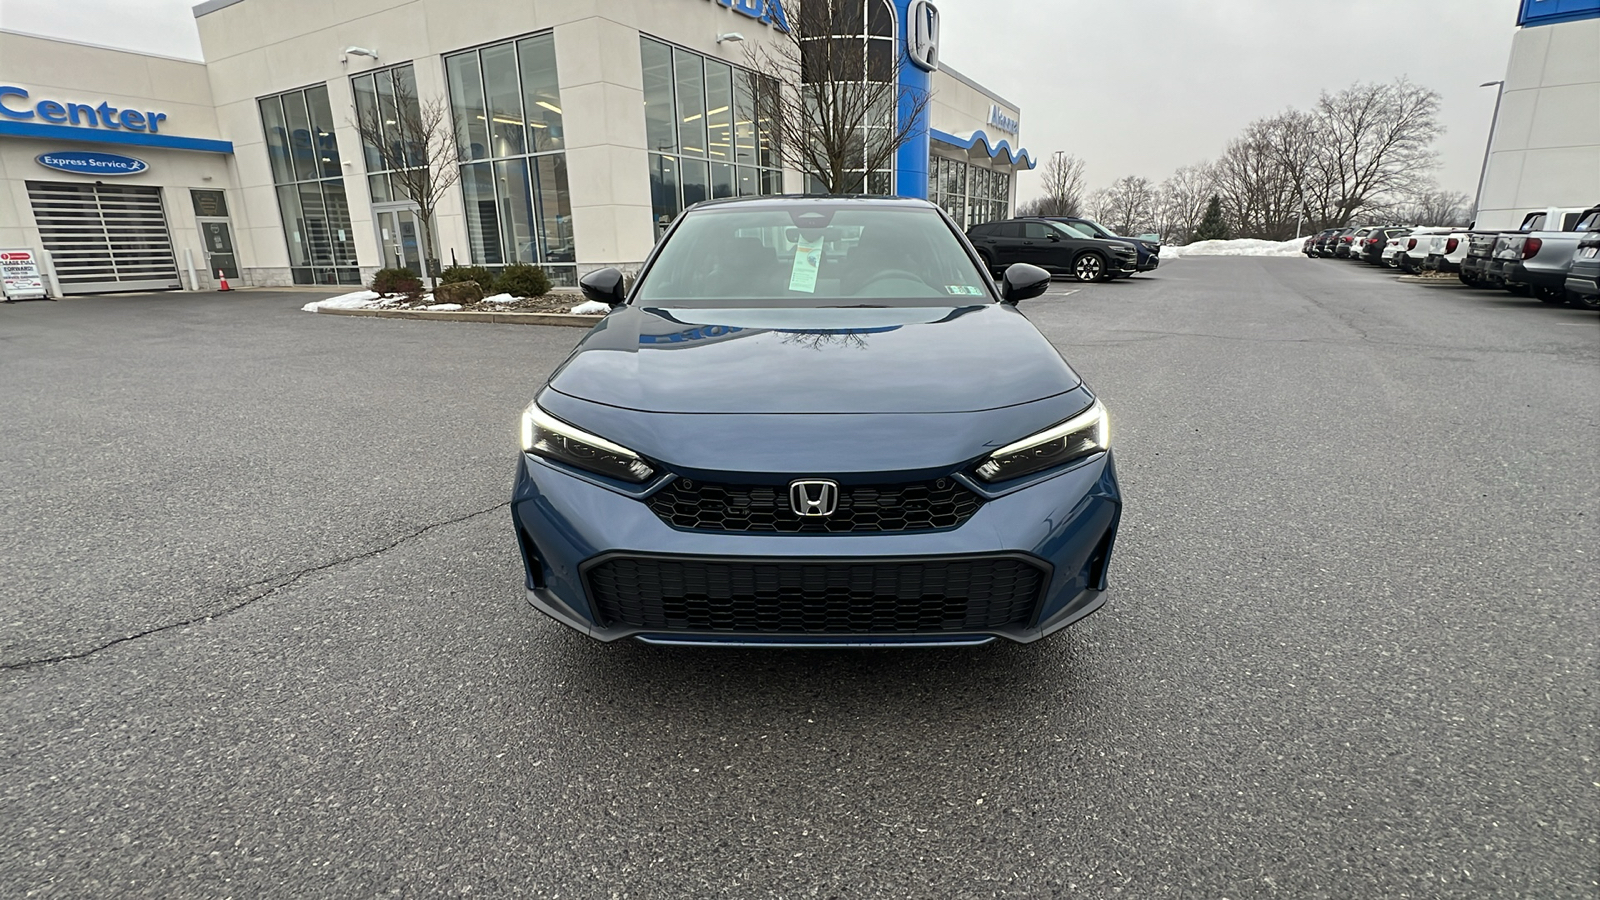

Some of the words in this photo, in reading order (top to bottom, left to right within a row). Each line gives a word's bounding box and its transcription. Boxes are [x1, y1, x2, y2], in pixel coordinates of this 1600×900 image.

[0, 85, 167, 133] Center
[44, 156, 87, 166] Express
[88, 158, 128, 169] Service
